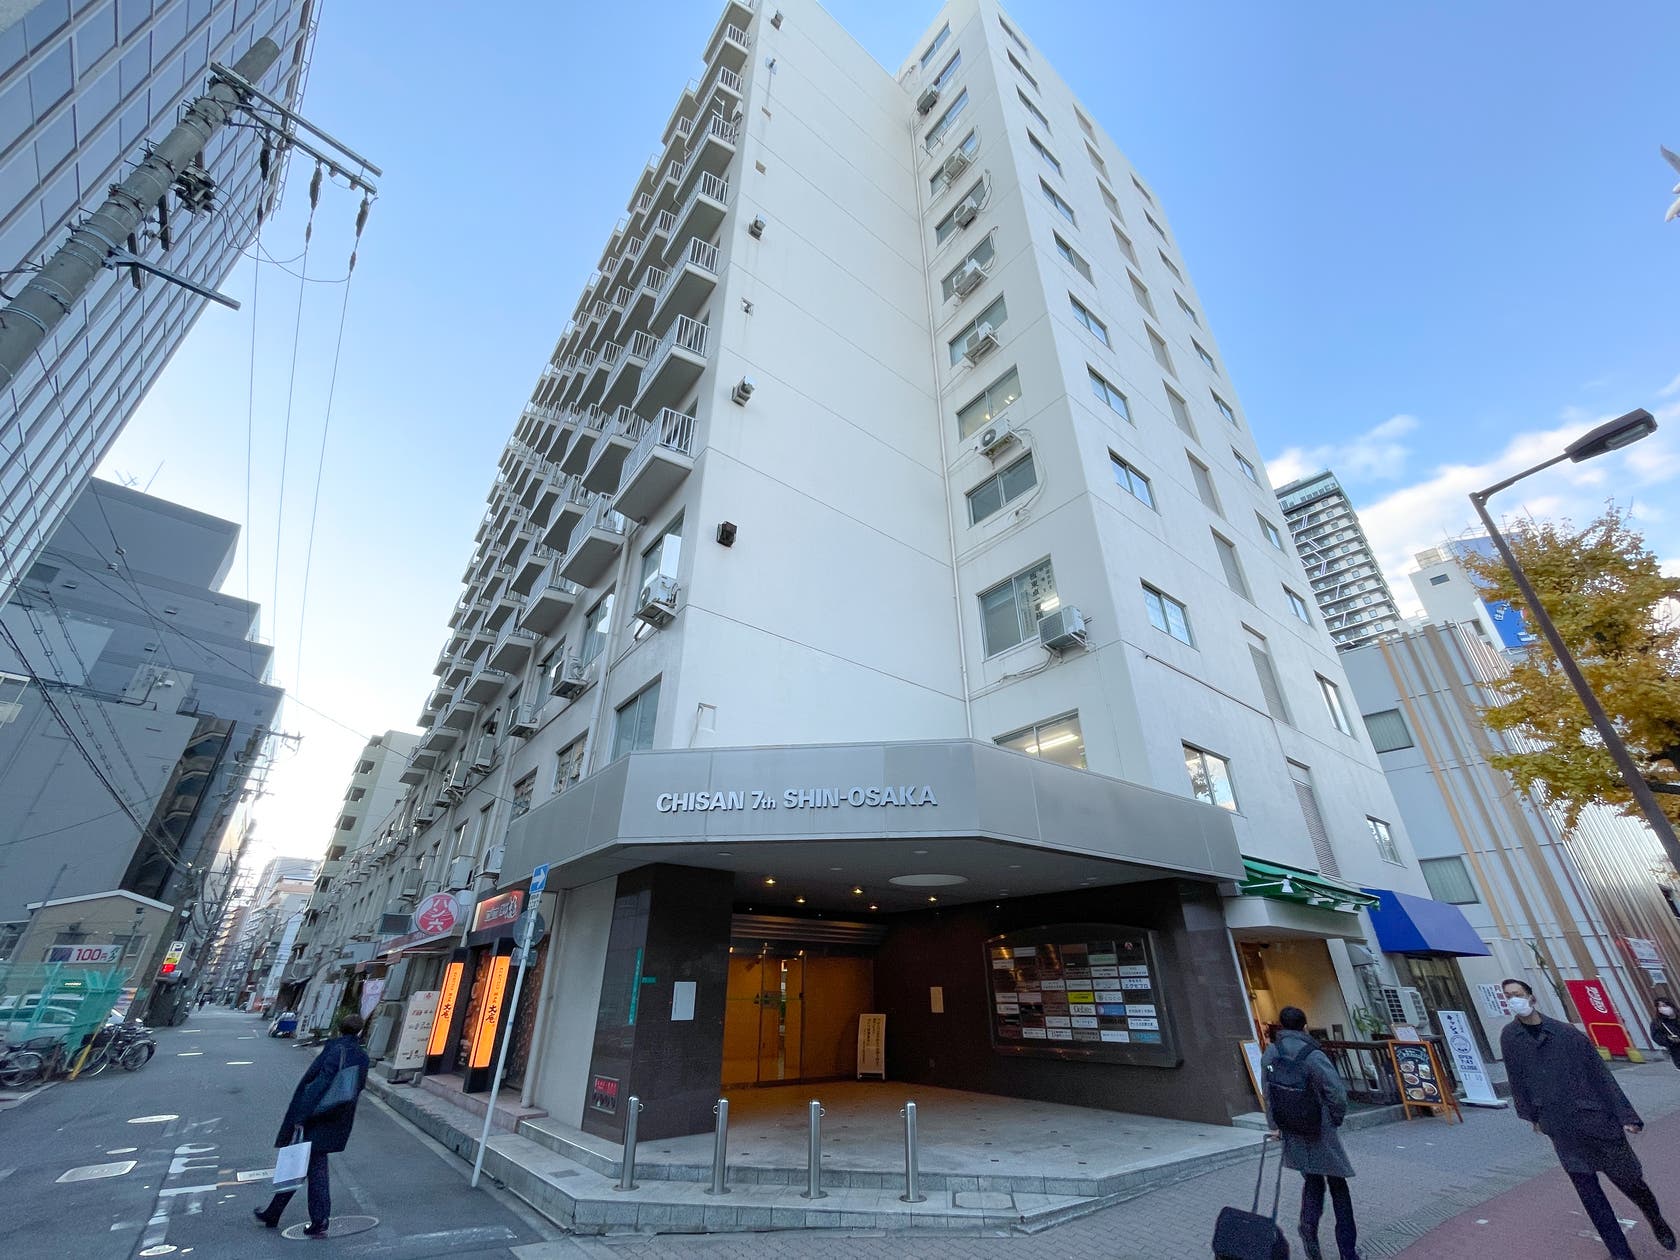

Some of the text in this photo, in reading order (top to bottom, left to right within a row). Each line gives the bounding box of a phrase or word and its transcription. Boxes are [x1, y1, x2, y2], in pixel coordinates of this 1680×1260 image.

[656, 785, 938, 813] CHISAN 7th SHIN-OSAKA
